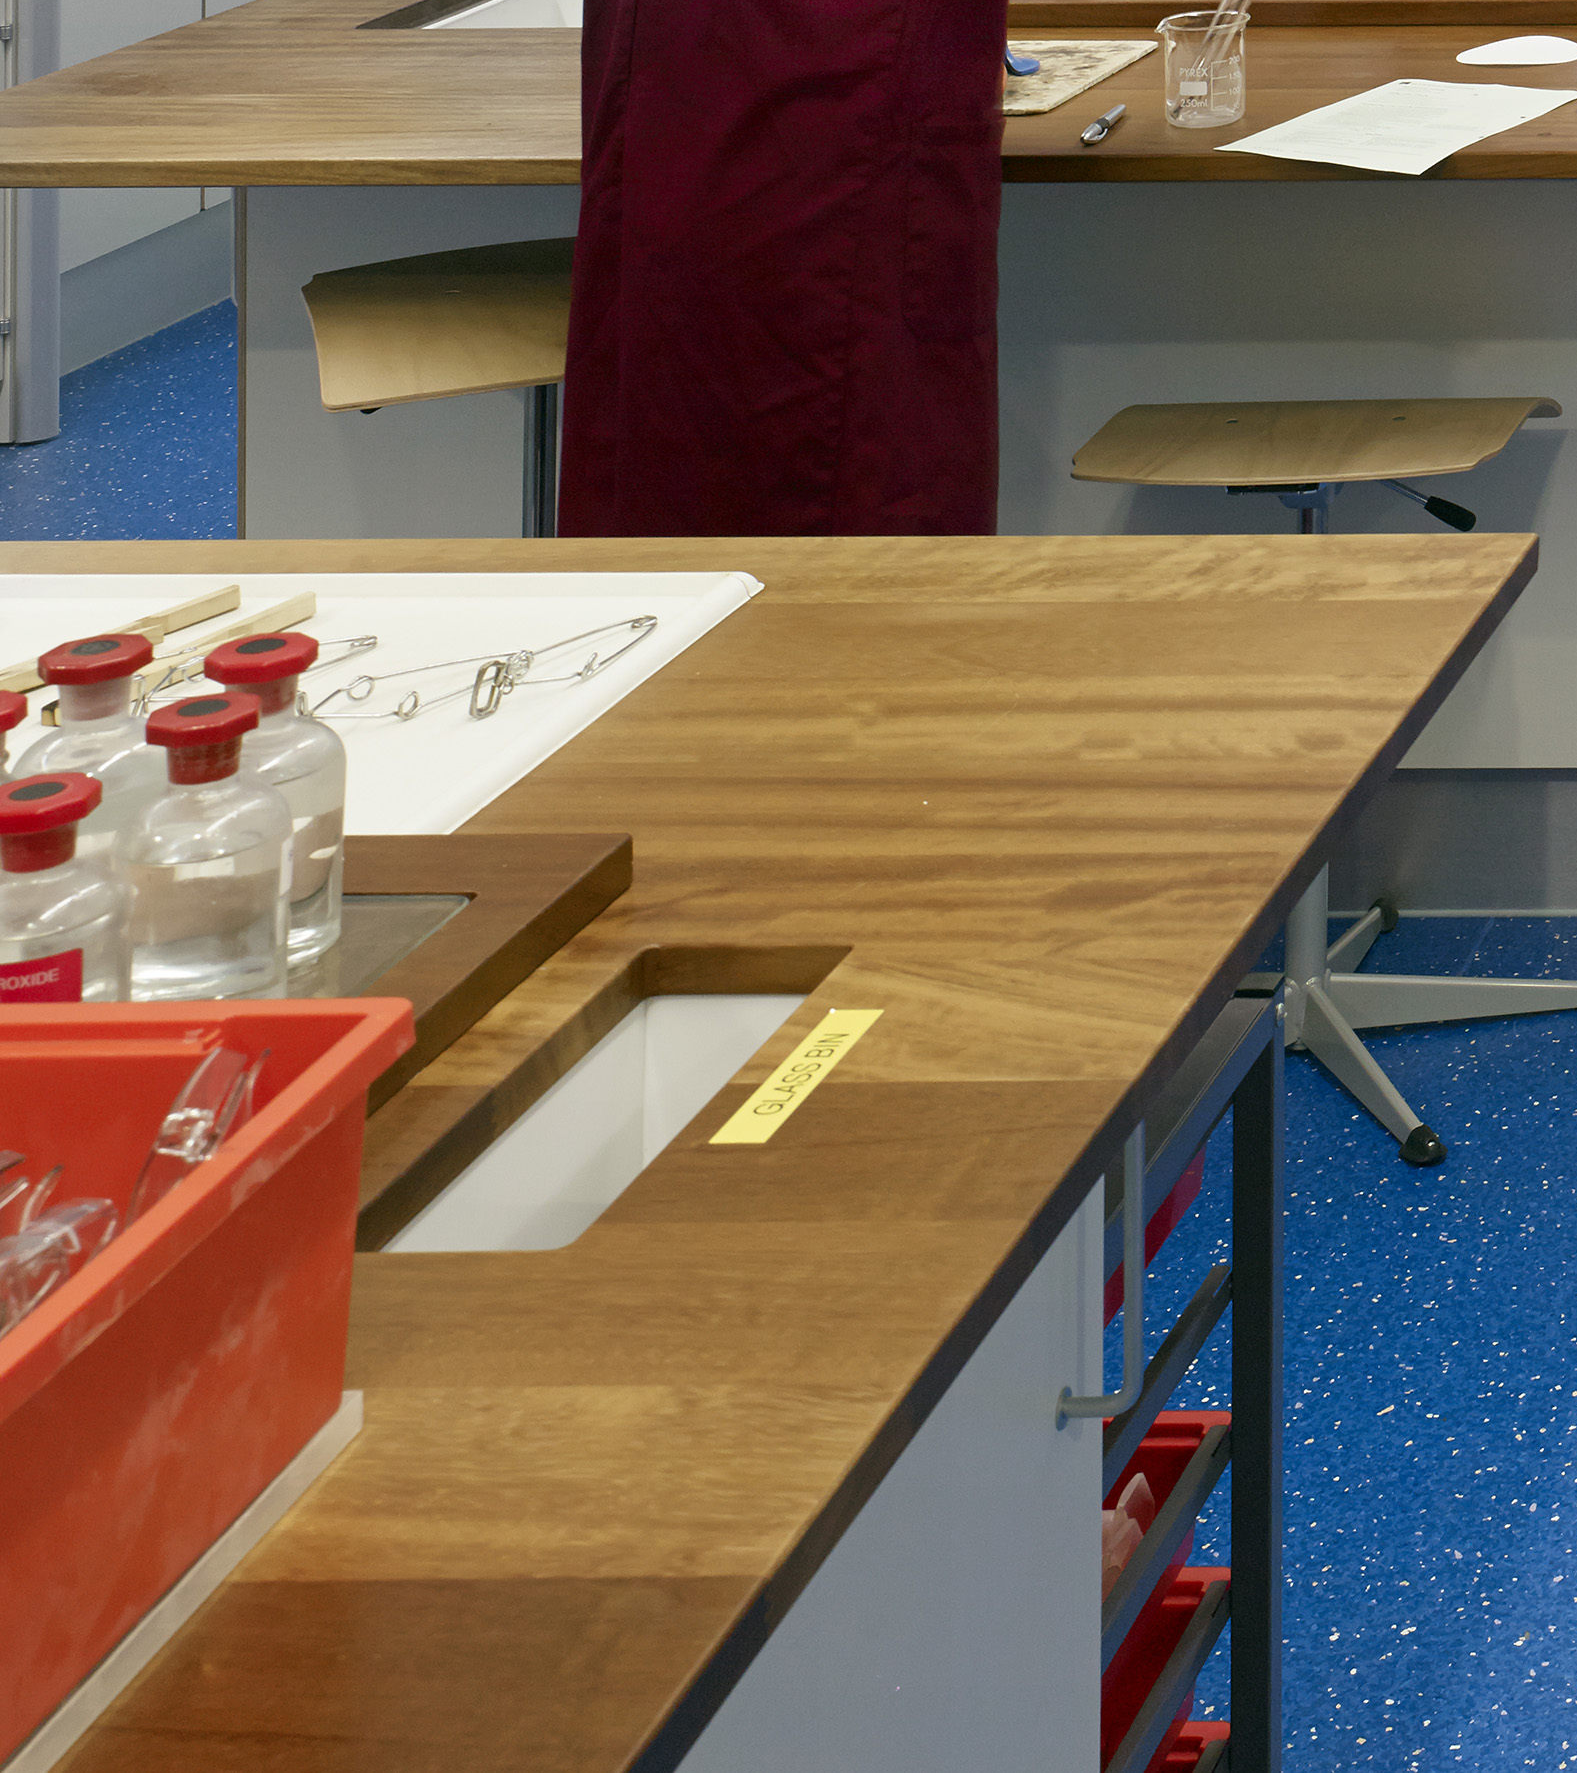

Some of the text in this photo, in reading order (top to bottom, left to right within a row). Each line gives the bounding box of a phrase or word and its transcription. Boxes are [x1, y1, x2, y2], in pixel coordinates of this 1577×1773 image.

[1179, 67, 1209, 77] PYREX
[1180, 99, 1208, 108] 250ml
[753, 1034, 850, 1115] GLASS BIN
